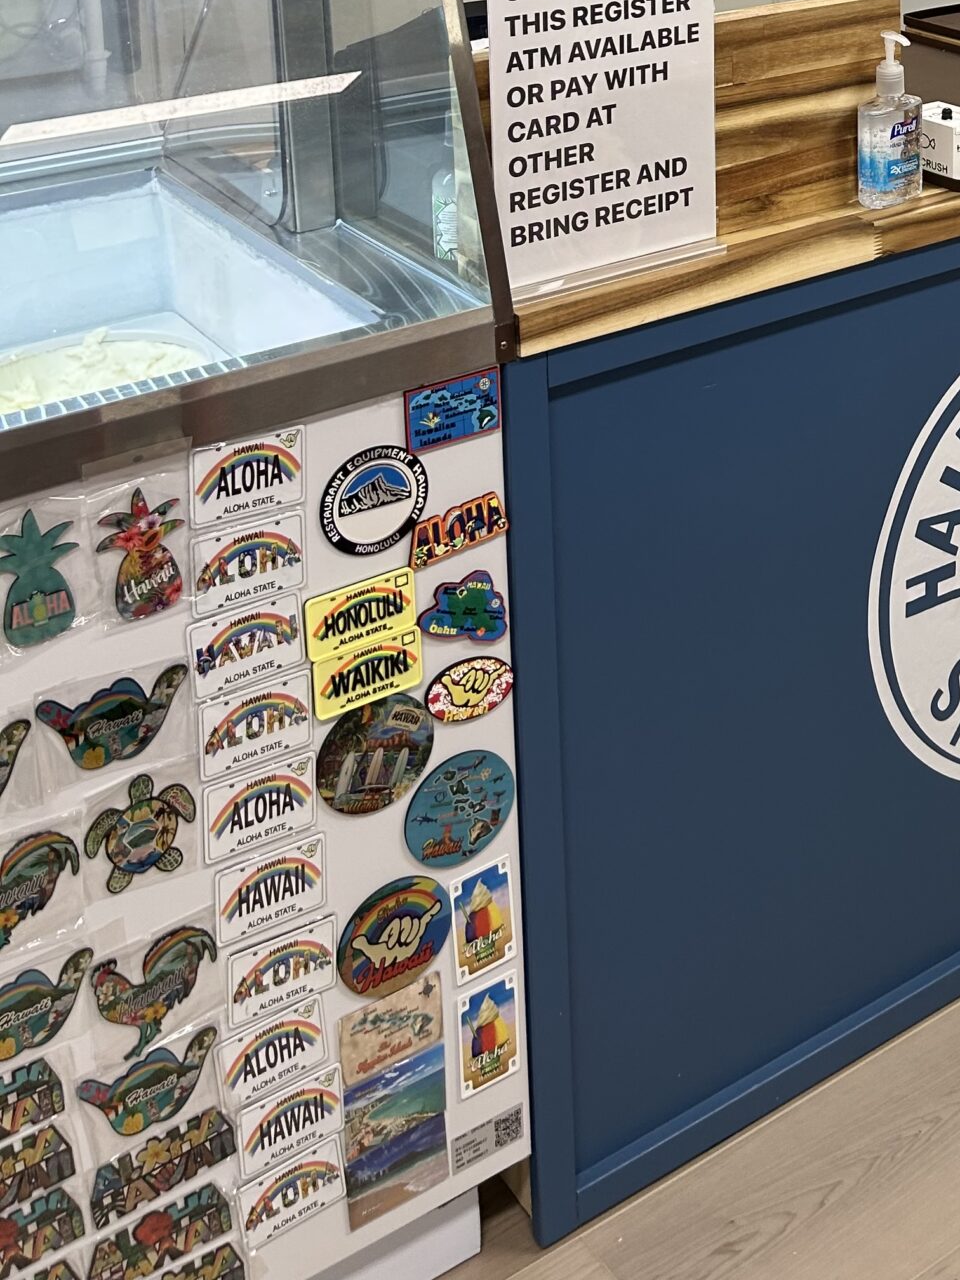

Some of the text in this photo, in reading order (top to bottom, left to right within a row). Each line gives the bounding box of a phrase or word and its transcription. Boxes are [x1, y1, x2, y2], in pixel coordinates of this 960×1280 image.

[504, 8, 567, 38] THIS
[505, 22, 700, 74] ATM AVAILABLE
[506, 60, 669, 109] OR PAY WITH
[507, 103, 617, 144] CARD AT
[508, 142, 595, 178] OTHER
[509, 156, 688, 214] REGISTER AND
[510, 186, 695, 248] BRING RECEIPT
[414, 421, 456, 438] Hawaiian
[420, 433, 452, 447] Islands
[233, 442, 265, 457] HAWAII
[216, 453, 284, 500] ALOHA
[223, 495, 276, 515] ALOHA STATE
[323, 471, 346, 543] RESTAURANT
[346, 447, 414, 471] EQUIPMENT
[233, 530, 264, 545] HAWAII
[354, 532, 400, 554] HONOLULU
[124, 561, 176, 604] Hawaii
[224, 581, 277, 603] ALOHA STATE
[346, 586, 376, 601] HAWAII
[229, 612, 261, 629] HAWAII
[322, 589, 404, 640] HONOLULU
[338, 623, 388, 646] ALOHA STATE
[353, 644, 383, 660] HAWAII
[224, 660, 276, 686] ALOHA STATE
[330, 649, 409, 699] WAIKIKI
[241, 691, 272, 709] HAWAII
[345, 681, 395, 705] ALOHA STATE
[87, 709, 144, 739] Hawaii
[232, 740, 284, 765] ALOHA STATE
[246, 774, 277, 791] HAWAII
[229, 783, 295, 834] ALOHA
[236, 822, 287, 847] ALOHA STATE
[256, 856, 287, 874] HAWAII
[237, 863, 306, 917] HAWAII
[247, 903, 297, 930] ALOHA STATE
[269, 940, 299, 958] HAWAII
[354, 941, 435, 994] Hawaii
[259, 985, 308, 1012] ALOHA STATE
[254, 1022, 285, 1041] HAWAII
[242, 1027, 306, 1083] ALOHA
[126, 1073, 178, 1107] Hawaii
[251, 1063, 300, 1094] ALOHA STATE
[276, 1089, 305, 1109] HAWAII
[259, 1092, 325, 1151] HAWAII
[270, 1131, 317, 1161] ALOHA STATE
[274, 1163, 304, 1184] HAWAII
[272, 1201, 319, 1232] ALOHA STATE
